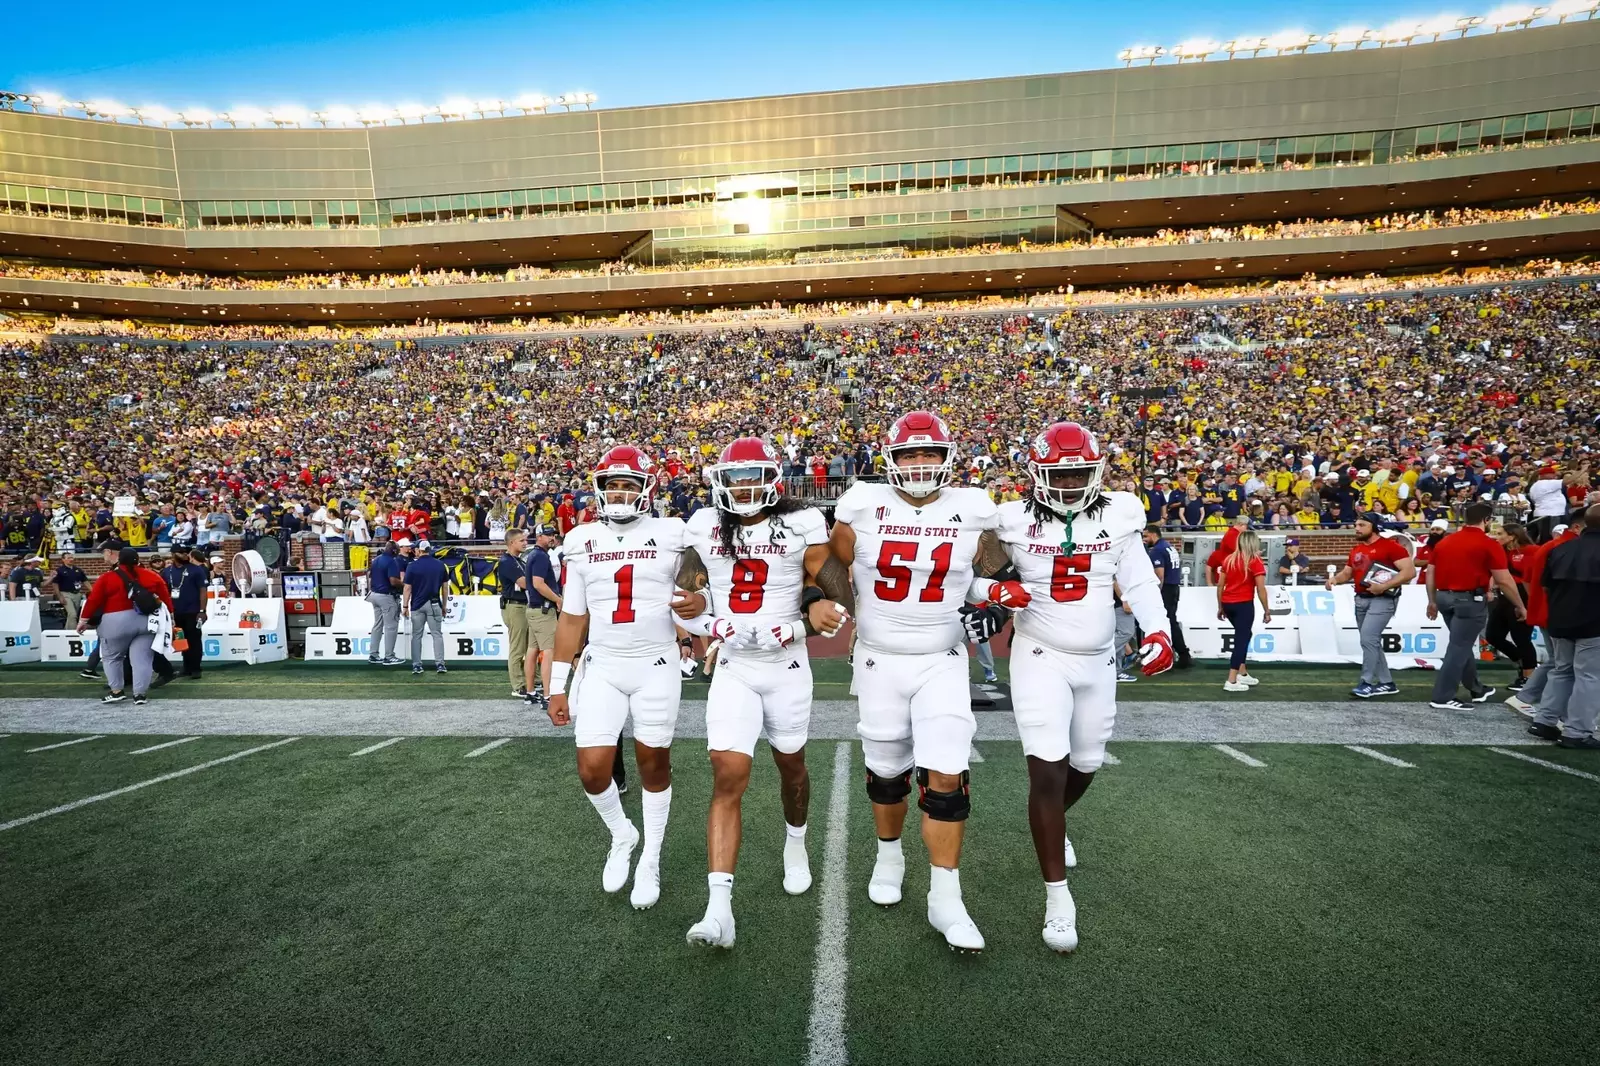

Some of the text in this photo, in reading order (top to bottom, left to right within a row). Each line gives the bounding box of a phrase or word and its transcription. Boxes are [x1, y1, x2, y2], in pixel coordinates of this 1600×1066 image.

[1228, 489, 1238, 501] 4
[392, 520, 405, 529] 23
[877, 525, 959, 538] FRESNO STATE
[754, 545, 787, 555] STATE
[1027, 541, 1111, 554] FRESN STATE
[588, 550, 657, 564] FRESNO STATE
[874, 540, 954, 603] 51
[1050, 553, 1092, 603] 6
[728, 558, 769, 614] 8
[612, 564, 636, 624] 1
